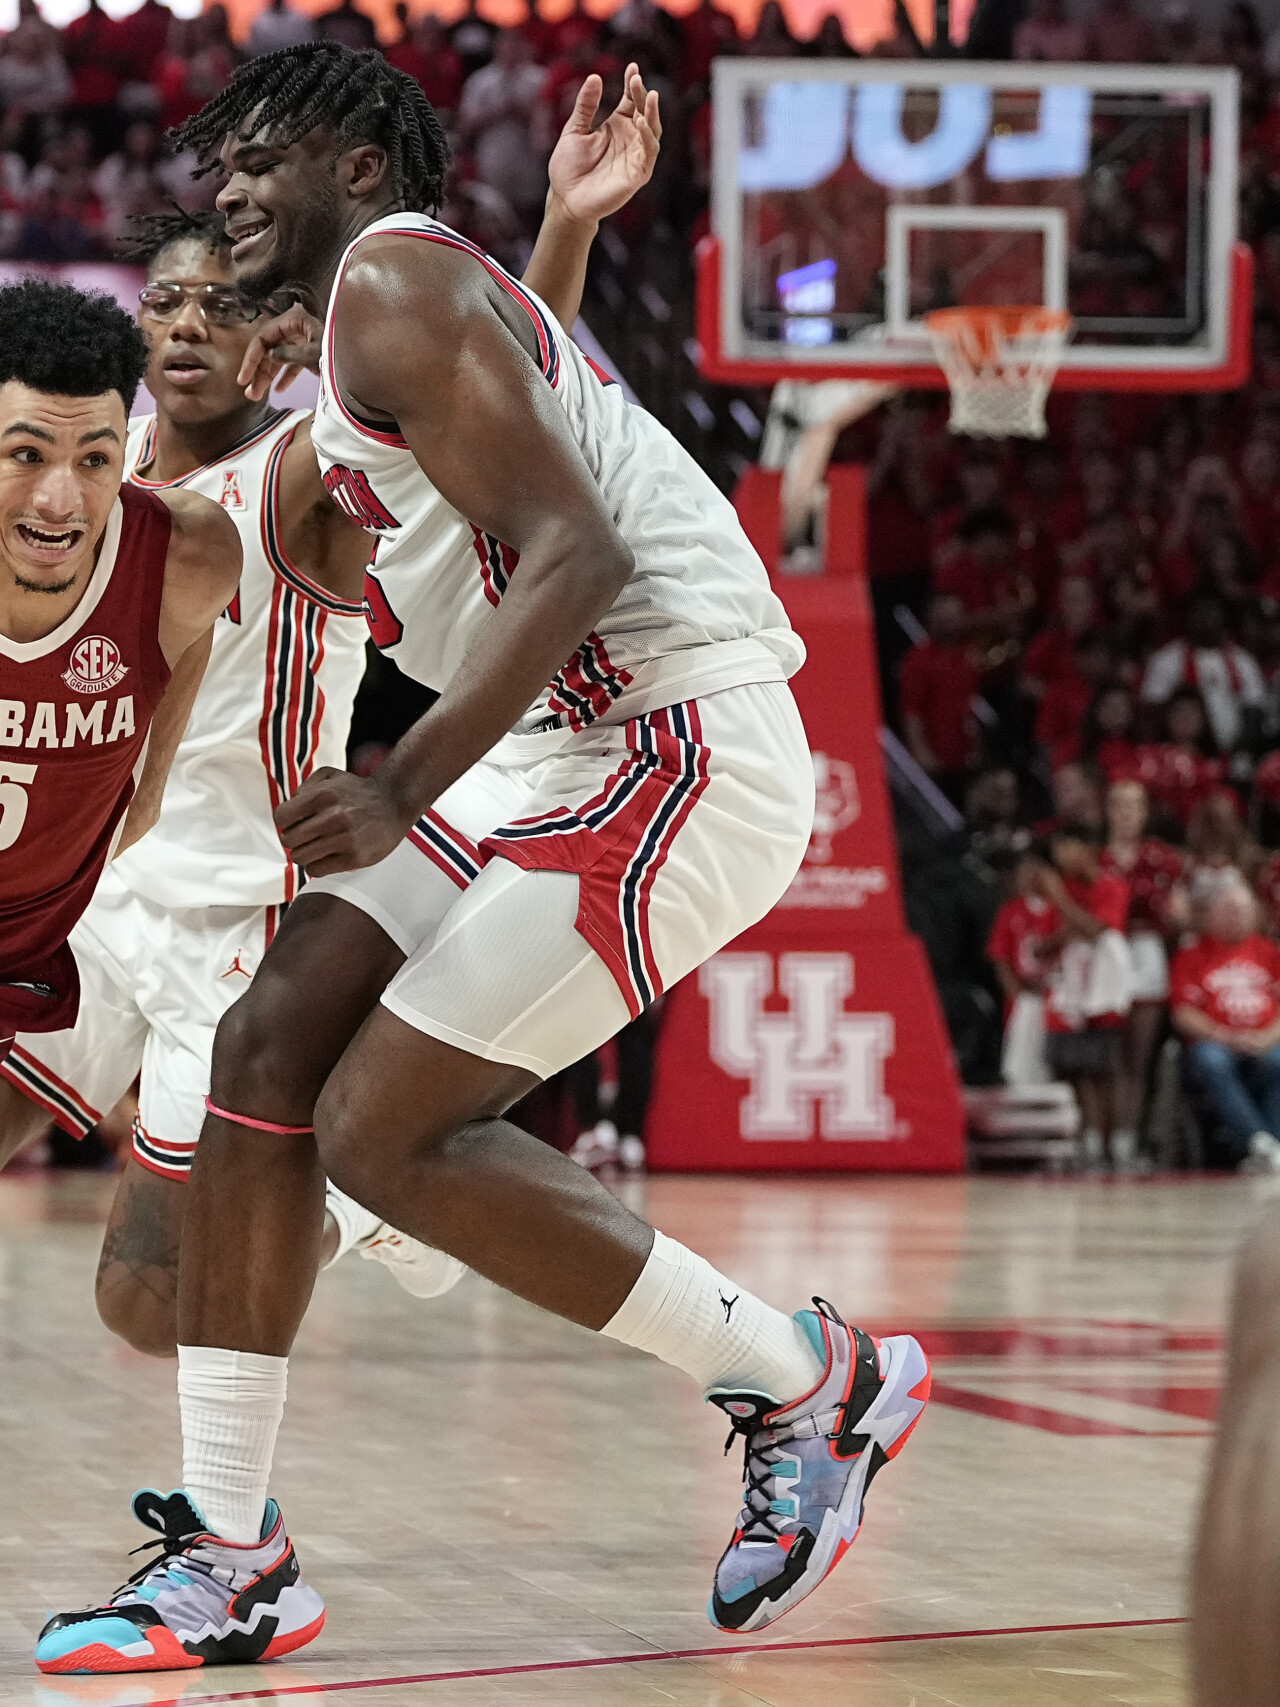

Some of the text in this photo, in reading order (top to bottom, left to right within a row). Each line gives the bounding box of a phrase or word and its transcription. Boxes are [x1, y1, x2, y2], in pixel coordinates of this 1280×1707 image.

[75, 640, 115, 679] SEC
[70, 674, 120, 692] GRADUATE
[698, 952, 897, 1141] UH
